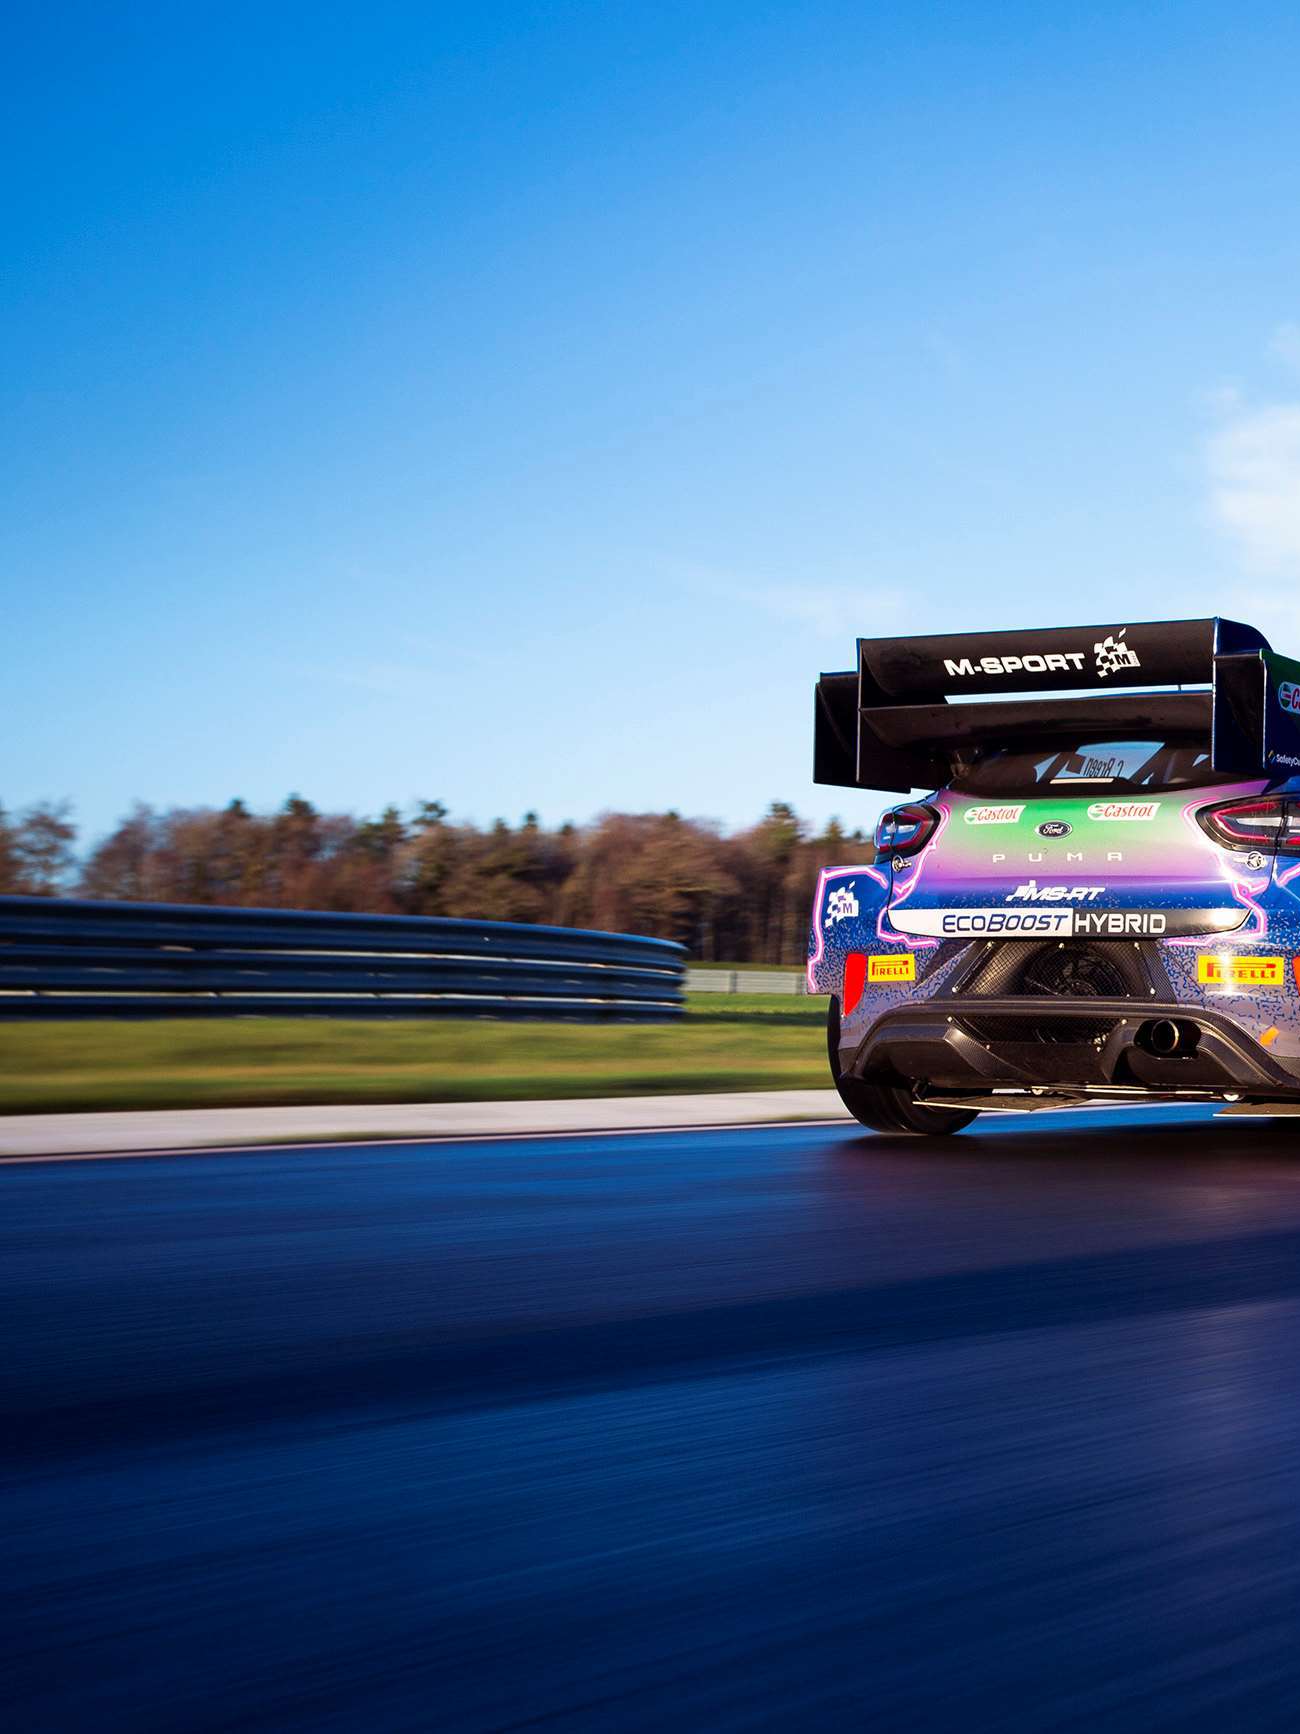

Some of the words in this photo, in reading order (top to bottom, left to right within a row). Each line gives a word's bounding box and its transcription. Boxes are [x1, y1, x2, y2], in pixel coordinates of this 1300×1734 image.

[943, 652, 1085, 676] M-SPORT
[978, 807, 1020, 821] Castrol
[1102, 803, 1155, 818] Castrol
[1042, 823, 1064, 835] Ford
[992, 851, 1122, 863] PUMA
[1074, 913, 1167, 934] HYBRID
[872, 960, 909, 976] PIRELLI
